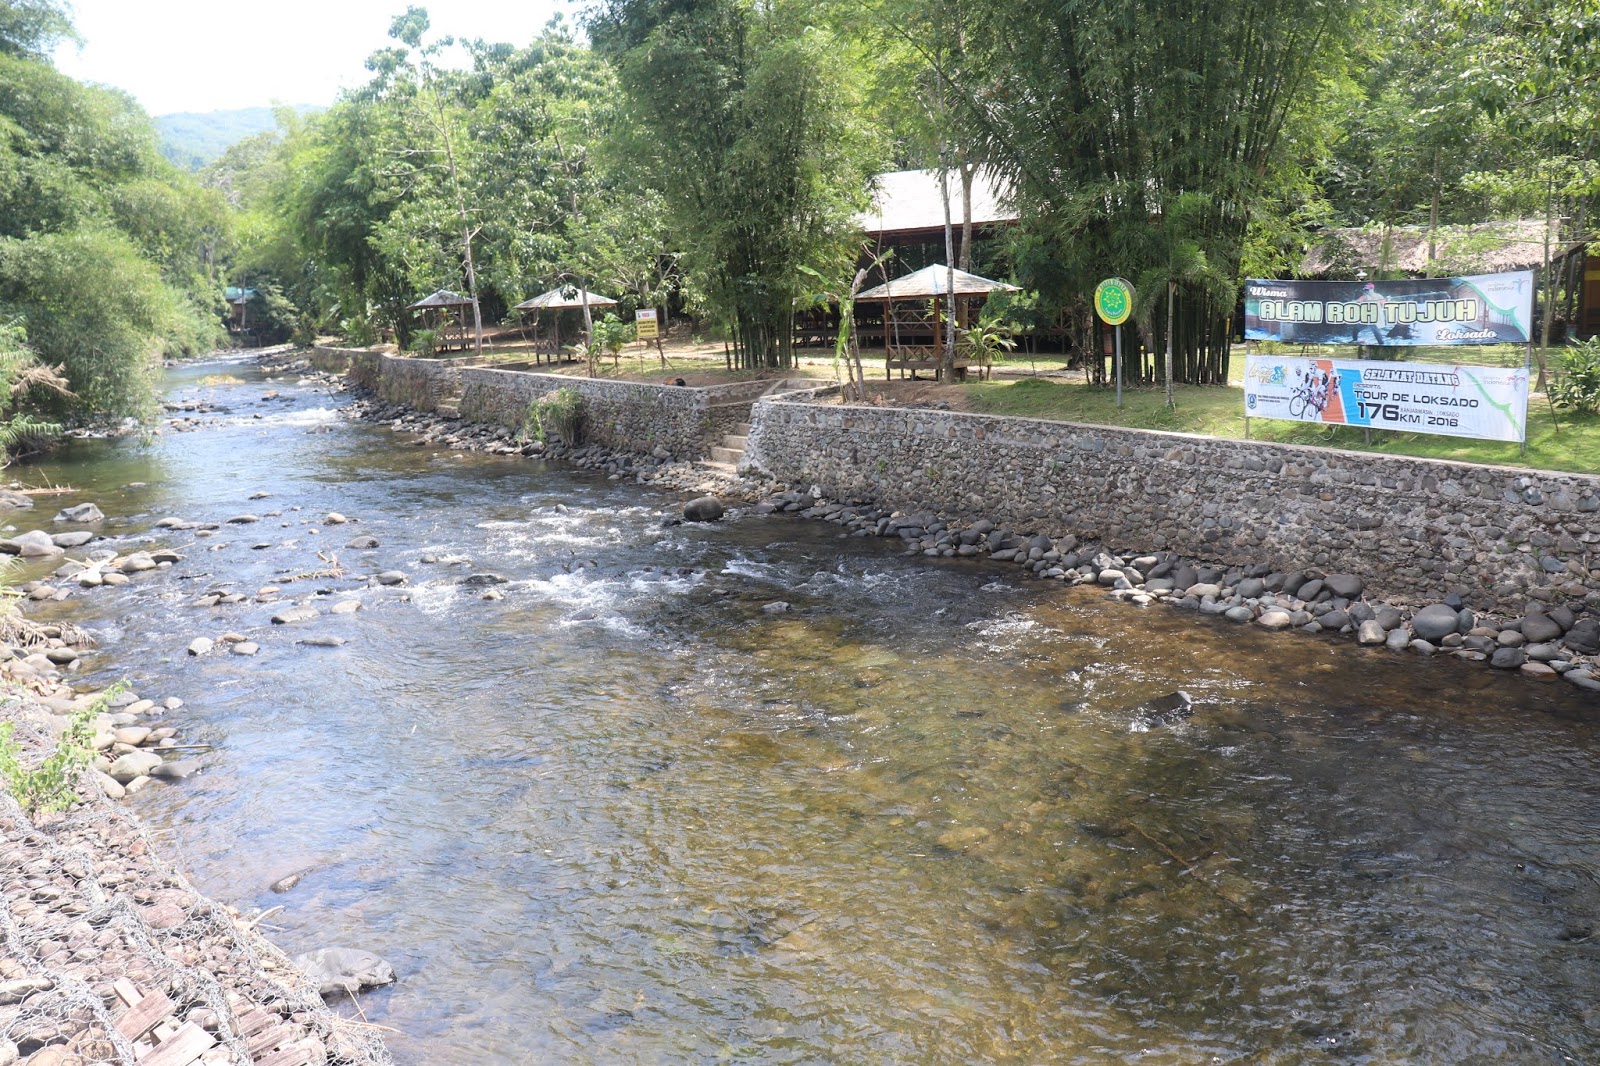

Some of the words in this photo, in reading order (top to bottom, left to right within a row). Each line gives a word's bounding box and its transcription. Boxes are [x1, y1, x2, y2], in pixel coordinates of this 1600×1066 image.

[1249, 286, 1288, 298] Wisma
[1259, 299, 1323, 323] ALAM
[1325, 301, 1379, 324] ROH
[1383, 298, 1478, 324] TUJUH
[1436, 328, 1498, 341] Loksado
[1363, 368, 1414, 383] SELAMAT
[1415, 370, 1460, 387] DATANG
[1354, 390, 1389, 401] TOUR
[1392, 393, 1410, 403] DE
[1413, 394, 1479, 408] LOKSADO
[1357, 402, 1400, 421] 176
[1399, 413, 1421, 424] KM
